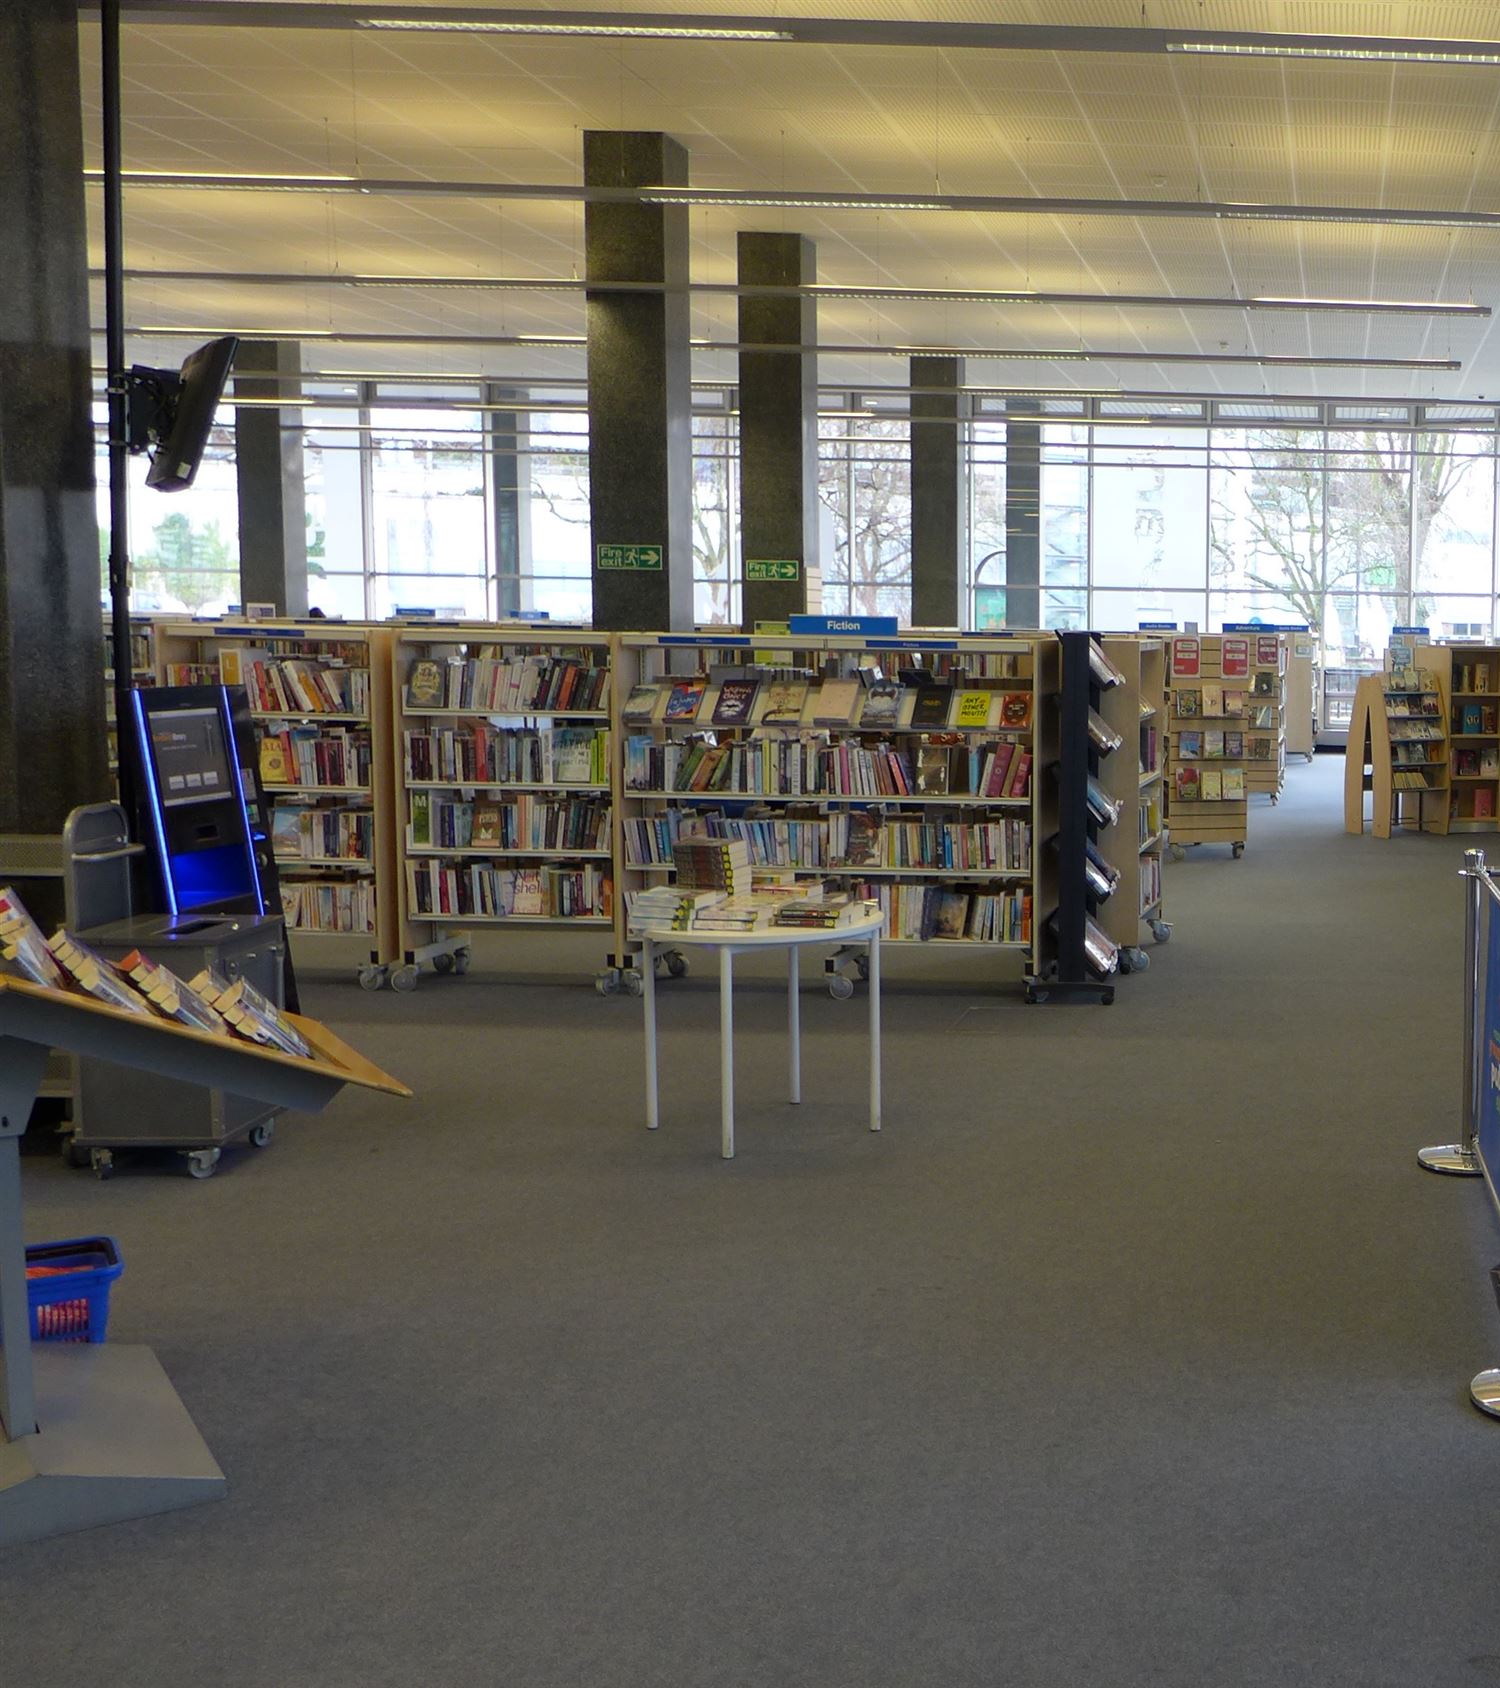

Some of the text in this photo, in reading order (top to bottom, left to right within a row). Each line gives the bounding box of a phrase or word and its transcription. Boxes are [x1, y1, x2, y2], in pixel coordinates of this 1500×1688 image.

[600, 547, 622, 557] Fire
[600, 558, 622, 567] exit
[749, 562, 766, 570] Fire
[749, 570, 767, 578] exit
[827, 620, 860, 630] Fiction
[414, 795, 426, 807] M
